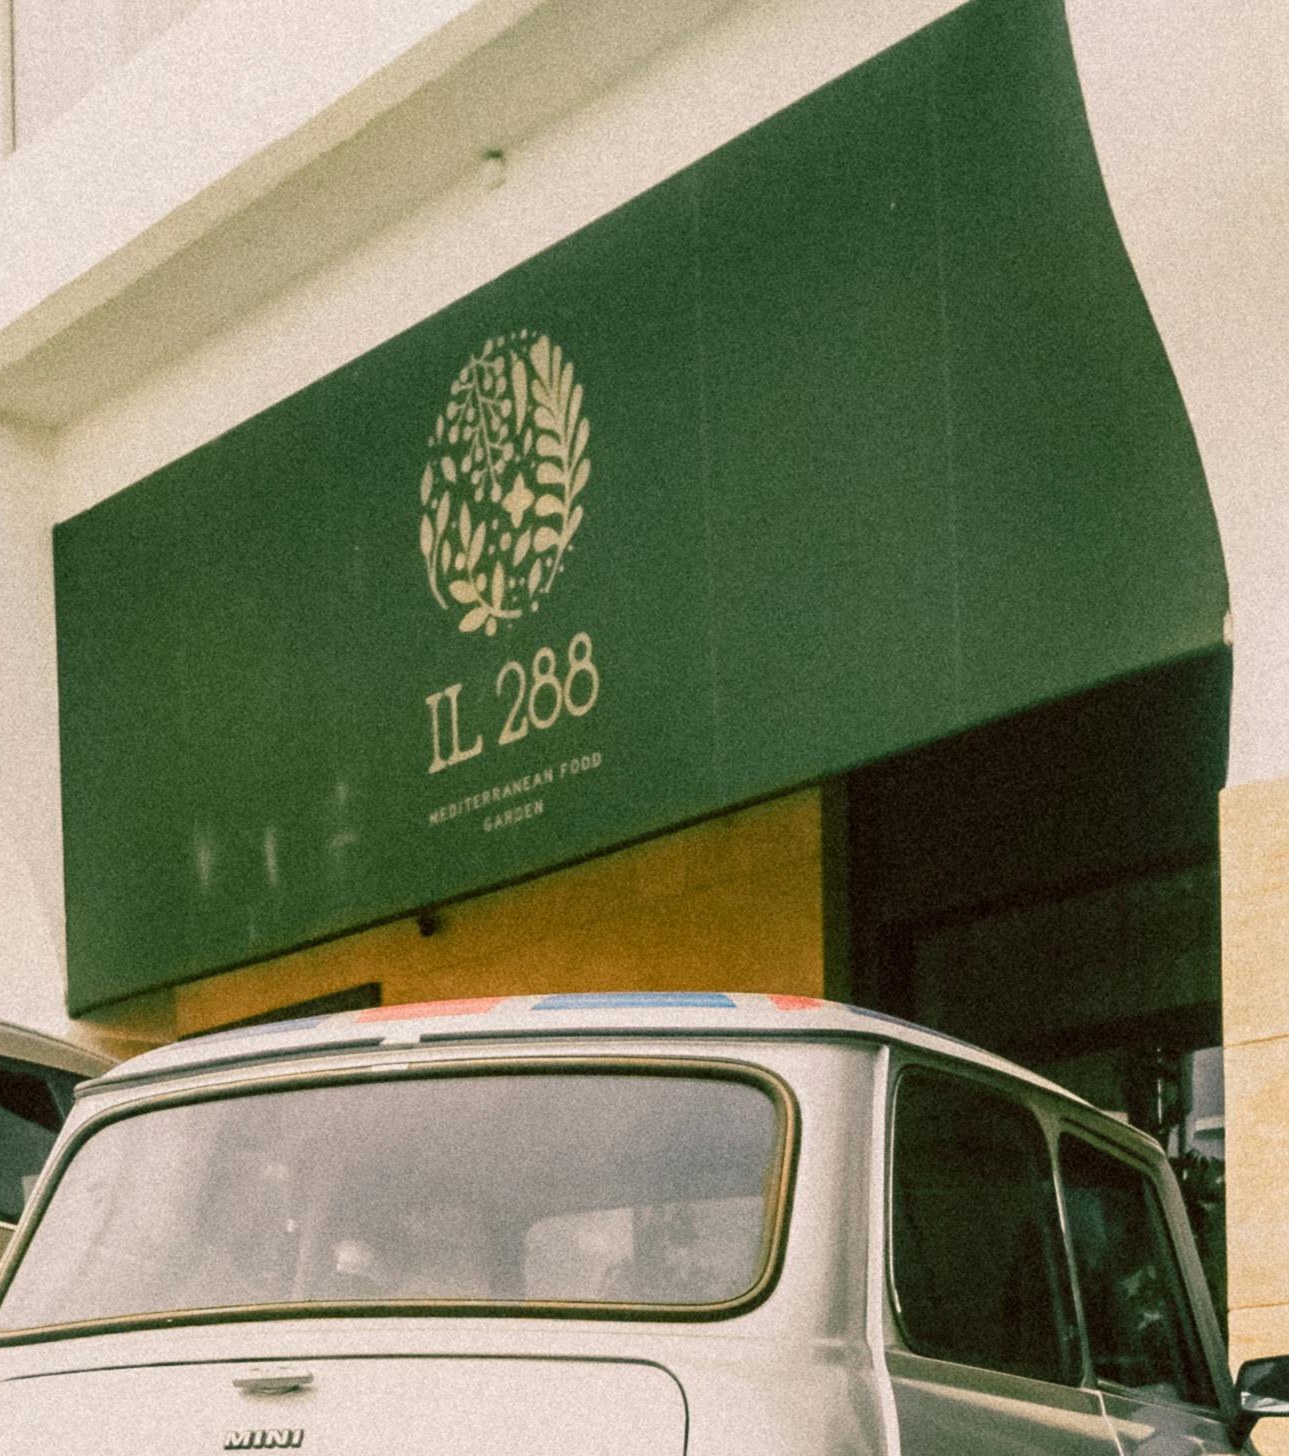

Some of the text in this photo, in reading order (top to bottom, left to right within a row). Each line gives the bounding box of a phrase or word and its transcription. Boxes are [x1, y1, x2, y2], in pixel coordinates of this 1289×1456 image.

[423, 630, 600, 775] IL 288
[428, 751, 602, 826] MEDITERRANEAN FOOD
[483, 799, 544, 832] GARDEN
[223, 1428, 305, 1451] MINI
